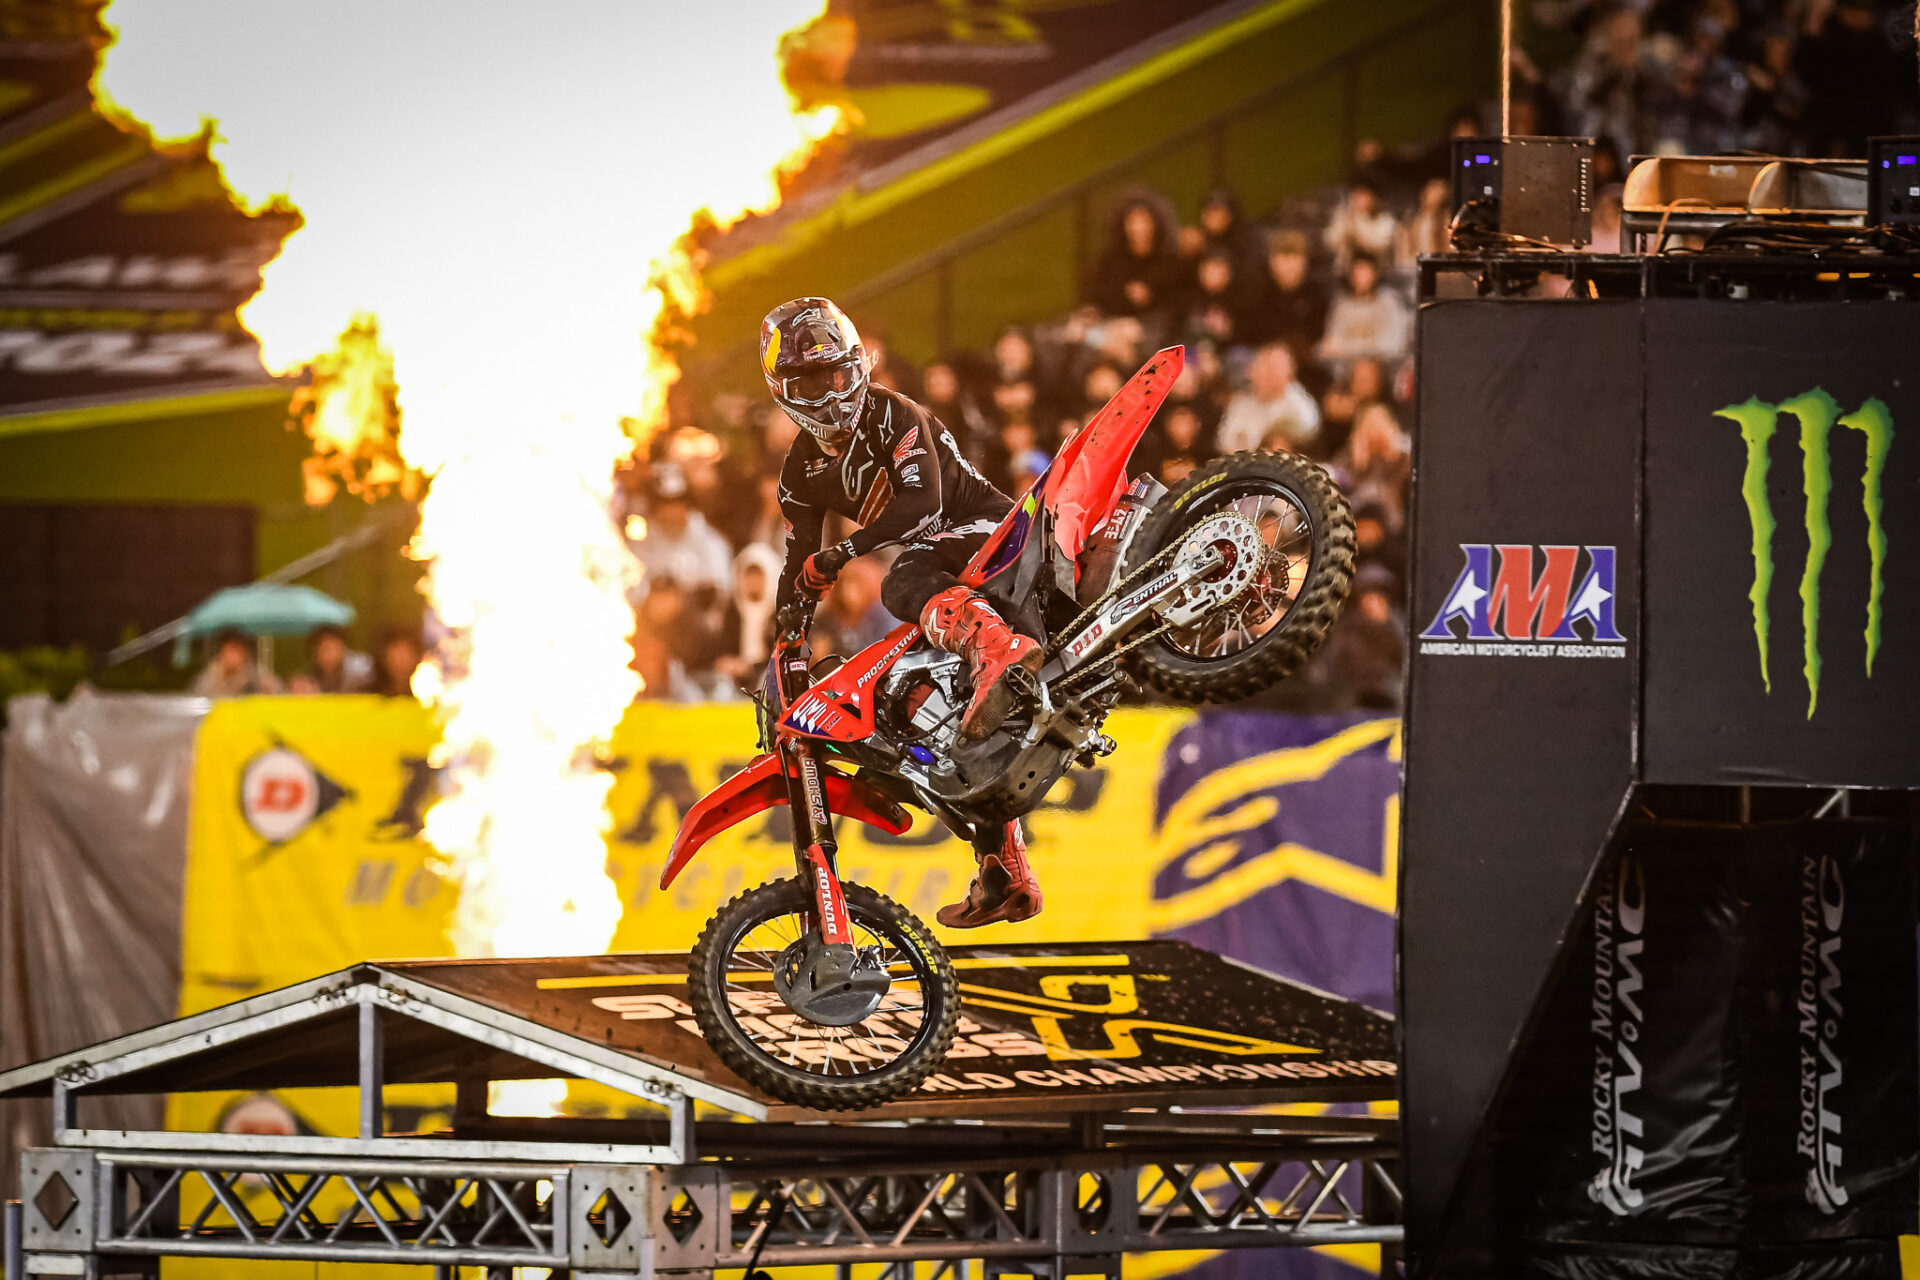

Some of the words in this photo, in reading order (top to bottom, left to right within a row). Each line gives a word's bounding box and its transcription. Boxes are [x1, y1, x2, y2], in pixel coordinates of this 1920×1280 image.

[1173, 472, 1228, 511] DUNLOP
[1110, 571, 1178, 625] RENTHAL
[1418, 543, 1627, 642] AMA
[857, 626, 919, 688] PROGRESSIVE
[1419, 642, 1475, 656] AMERICAN
[1475, 643, 1555, 657] MOTORCYCLIST
[1556, 644, 1626, 658] ASSOCIATION
[816, 866, 838, 935] DUNLOP
[902, 923, 939, 975] DUNLOP
[1592, 869, 1613, 1042] MOUNTA
[1797, 855, 1819, 1040] MOUNTAIN
[1014, 1059, 1398, 1088] CHAMPIONSHIP
[1591, 1046, 1614, 1160] ROCKY
[1797, 1046, 1817, 1160] ROCKY
